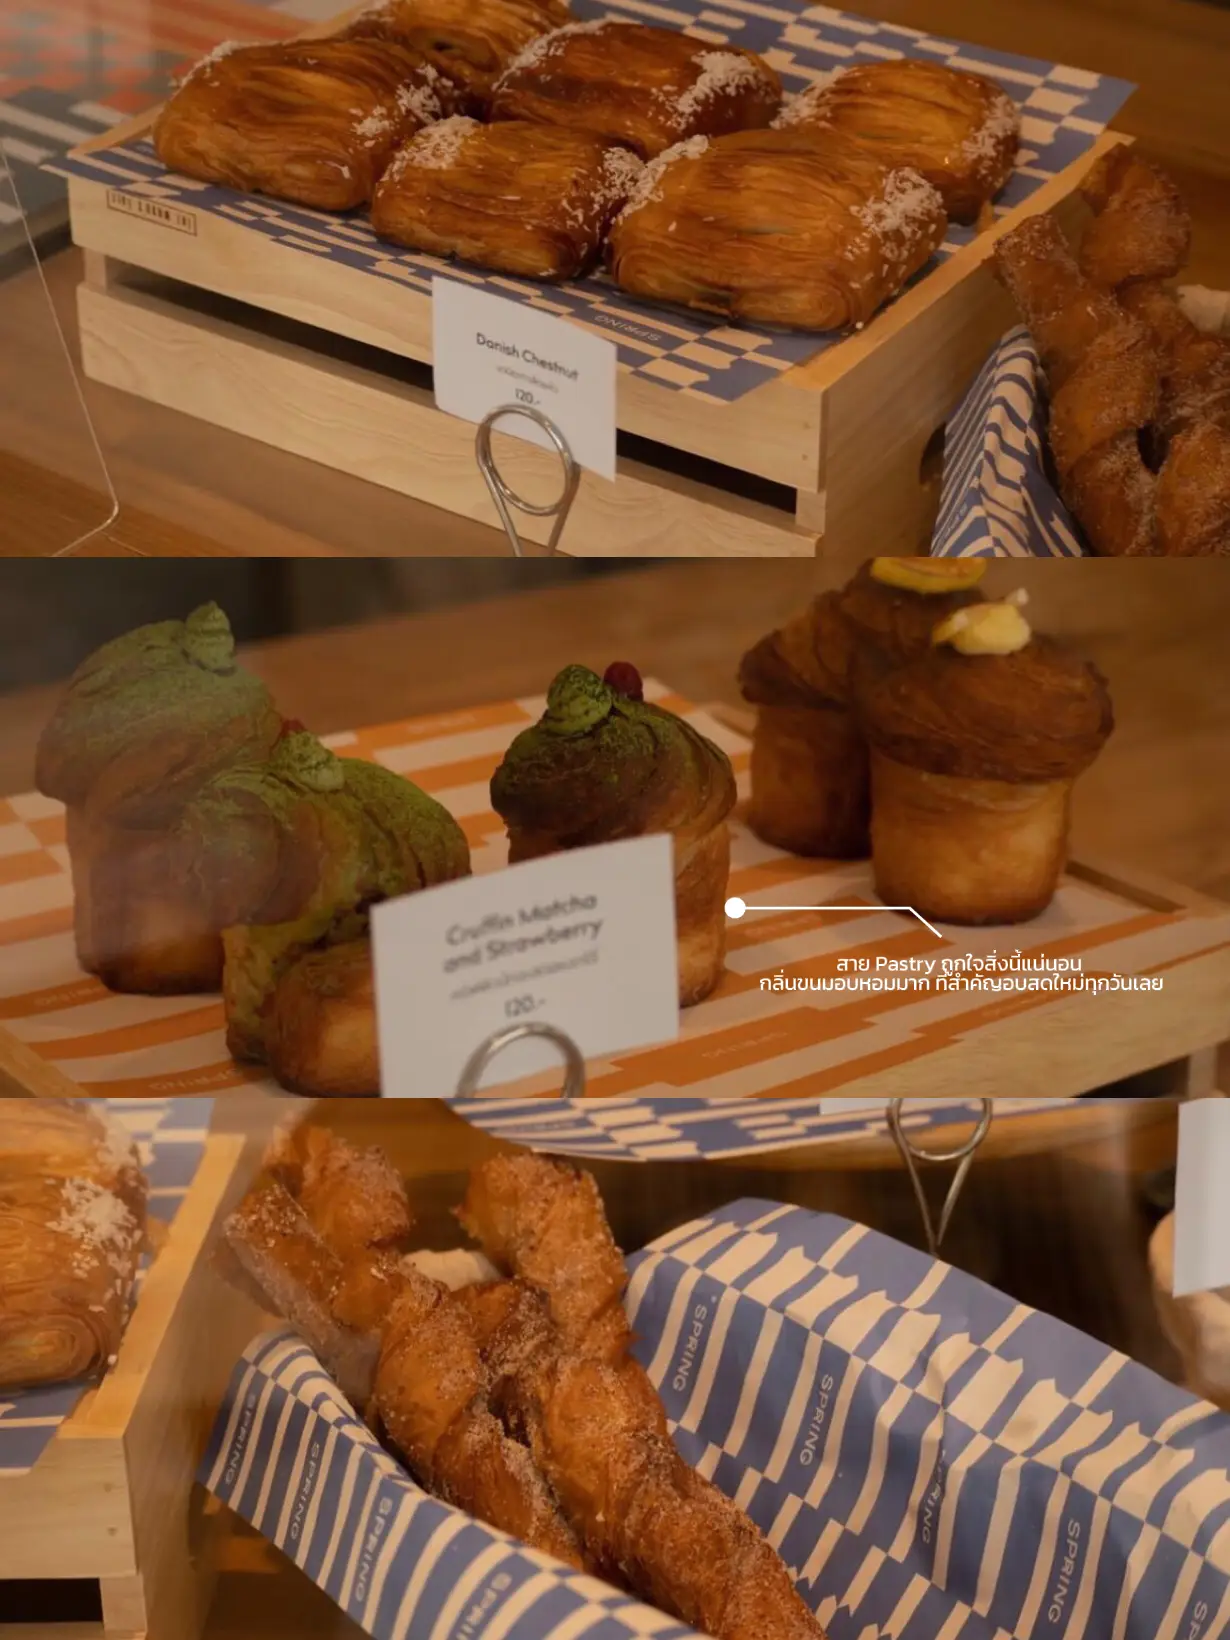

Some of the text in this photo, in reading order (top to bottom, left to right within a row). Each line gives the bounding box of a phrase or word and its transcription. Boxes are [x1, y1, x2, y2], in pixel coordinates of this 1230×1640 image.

[476, 331, 520, 360] Danish
[521, 348, 579, 382] Chestnut
[594, 314, 662, 342] SPRING
[443, 918, 604, 973] and Strawberry
[445, 894, 597, 946] Cruffin Matcha
[672, 1304, 708, 1392] SPRING
[224, 1393, 257, 1486] SPRING
[799, 1374, 835, 1467] SPRING
[290, 1441, 321, 1540] SPRING
[355, 1496, 394, 1603] SPRING
[1047, 1519, 1082, 1624] SPRING
